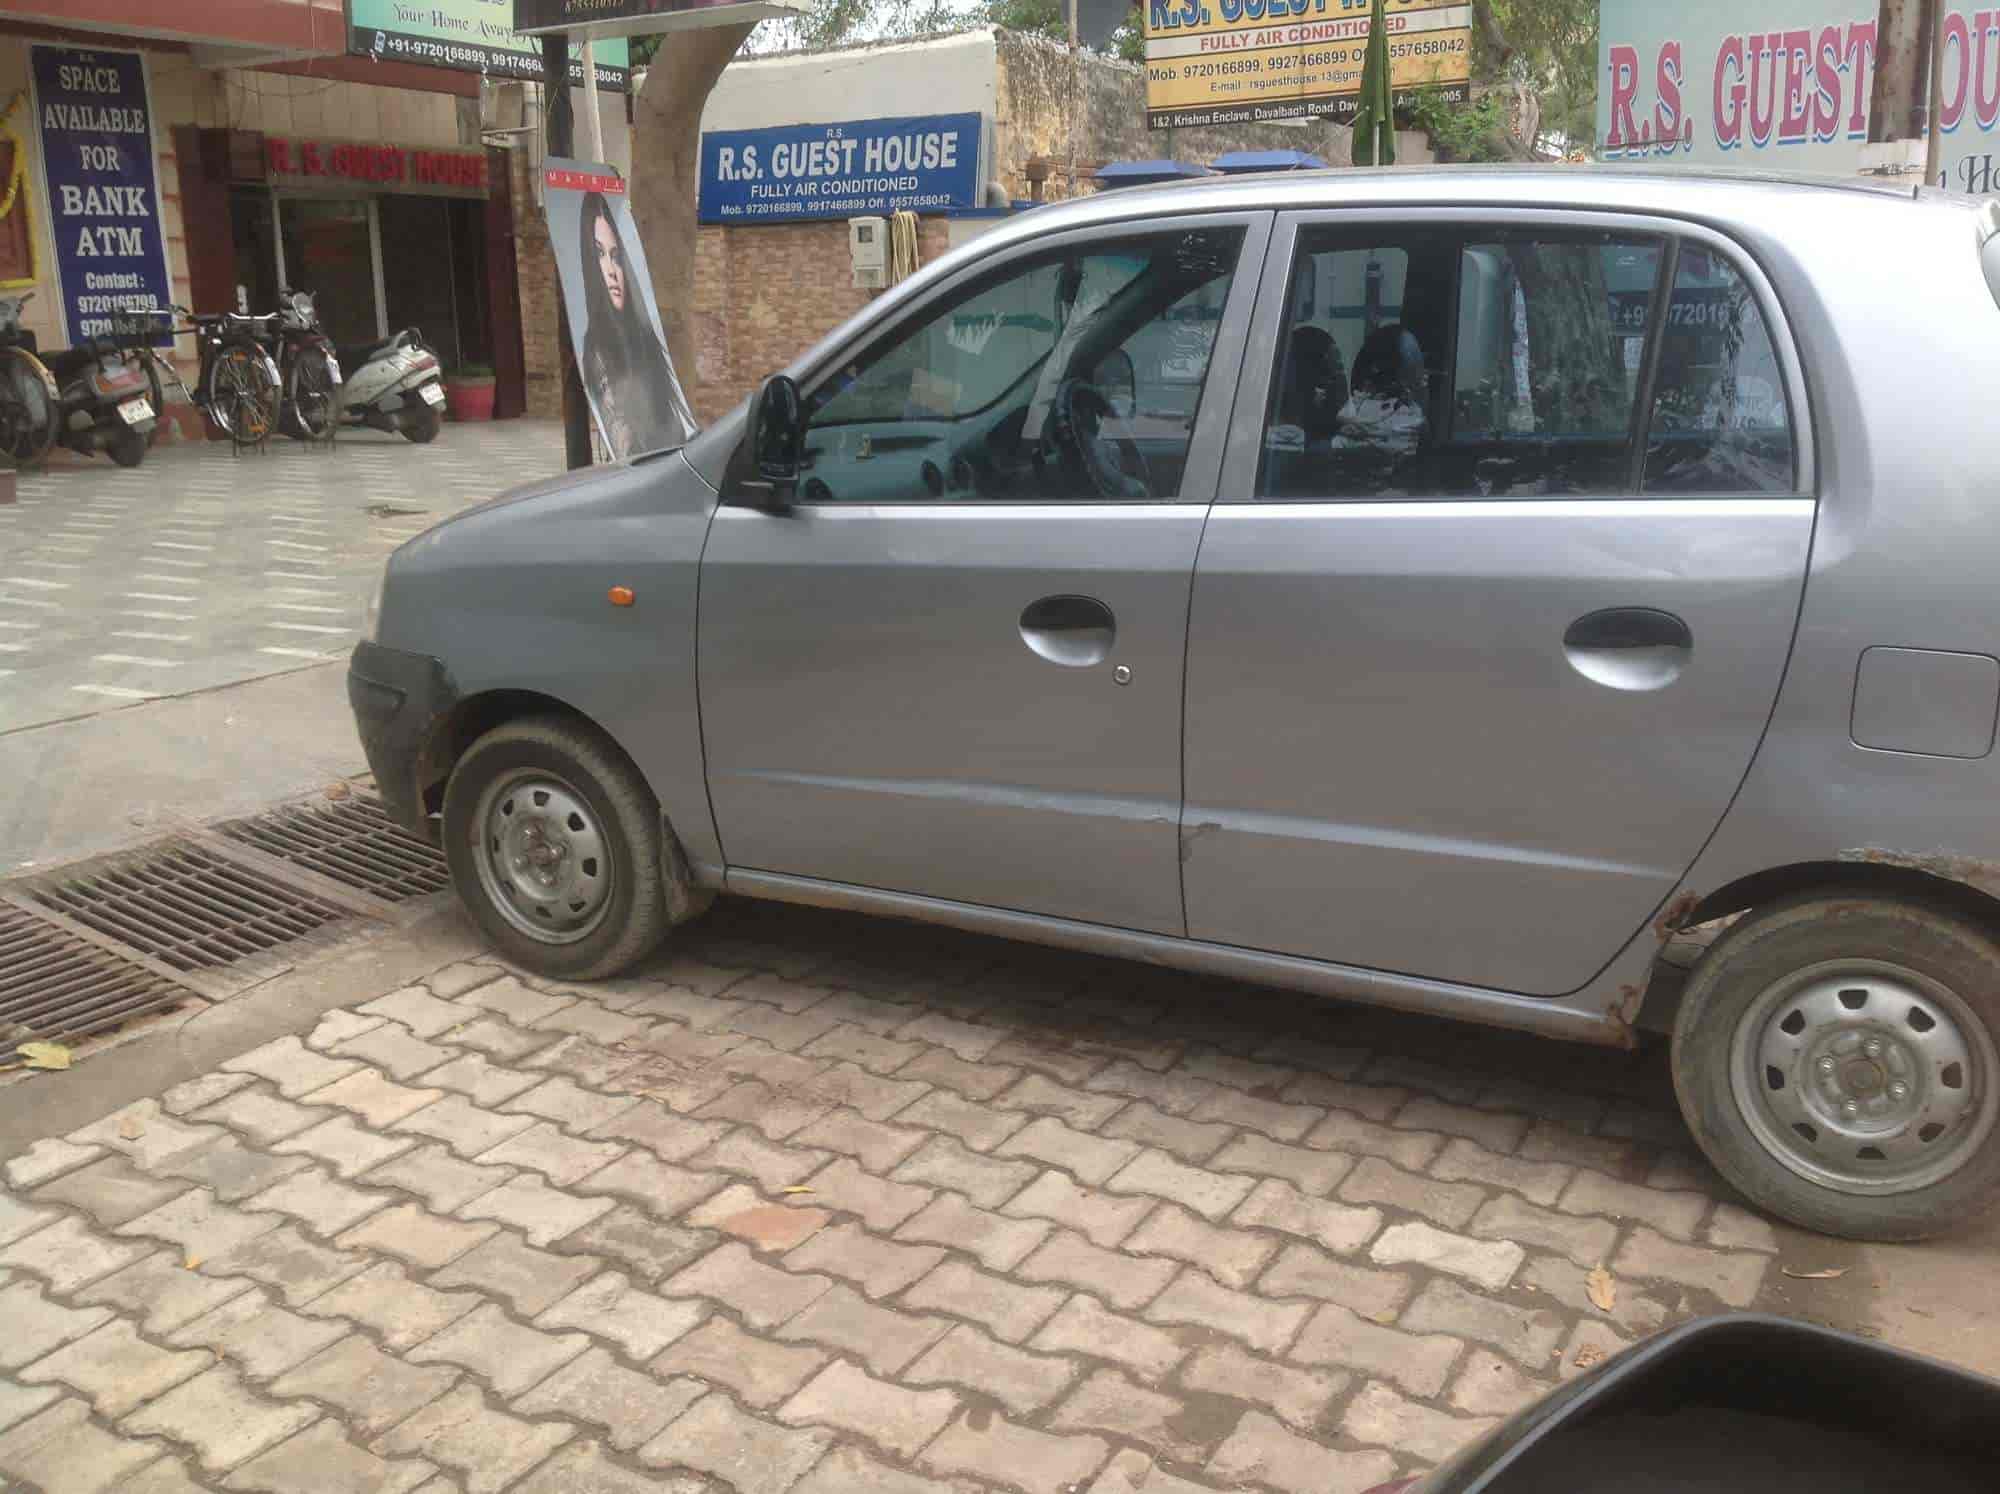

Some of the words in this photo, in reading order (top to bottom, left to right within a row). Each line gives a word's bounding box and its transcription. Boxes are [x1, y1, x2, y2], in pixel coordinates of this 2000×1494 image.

[394, 3, 424, 24] Your
[431, 9, 469, 31] Home
[1200, 33, 1250, 51] FULLY
[1255, 30, 1285, 46] AIR
[1288, 16, 1407, 42] CONDITIOED
[1268, 50, 1348, 70] 9927466899
[1390, 38, 1465, 58] 557658042
[59, 65, 121, 94] SPACE
[1605, 42, 1694, 159] R.S.
[1713, 20, 1877, 152] GUEST
[45, 104, 145, 133] AVAILABLE
[1174, 112, 1211, 127] Krishna
[80, 145, 121, 171] FOR
[331, 143, 407, 183] GUEST
[415, 150, 489, 188] HOUSE
[718, 144, 764, 181] R.S.
[771, 138, 858, 179] GUEST
[865, 130, 958, 173] HOUSE
[60, 184, 149, 217] BANK
[751, 182, 792, 199] FULLY
[794, 181, 818, 196] AIR
[821, 175, 918, 195] CONDITIONED
[76, 227, 145, 257] ATM
